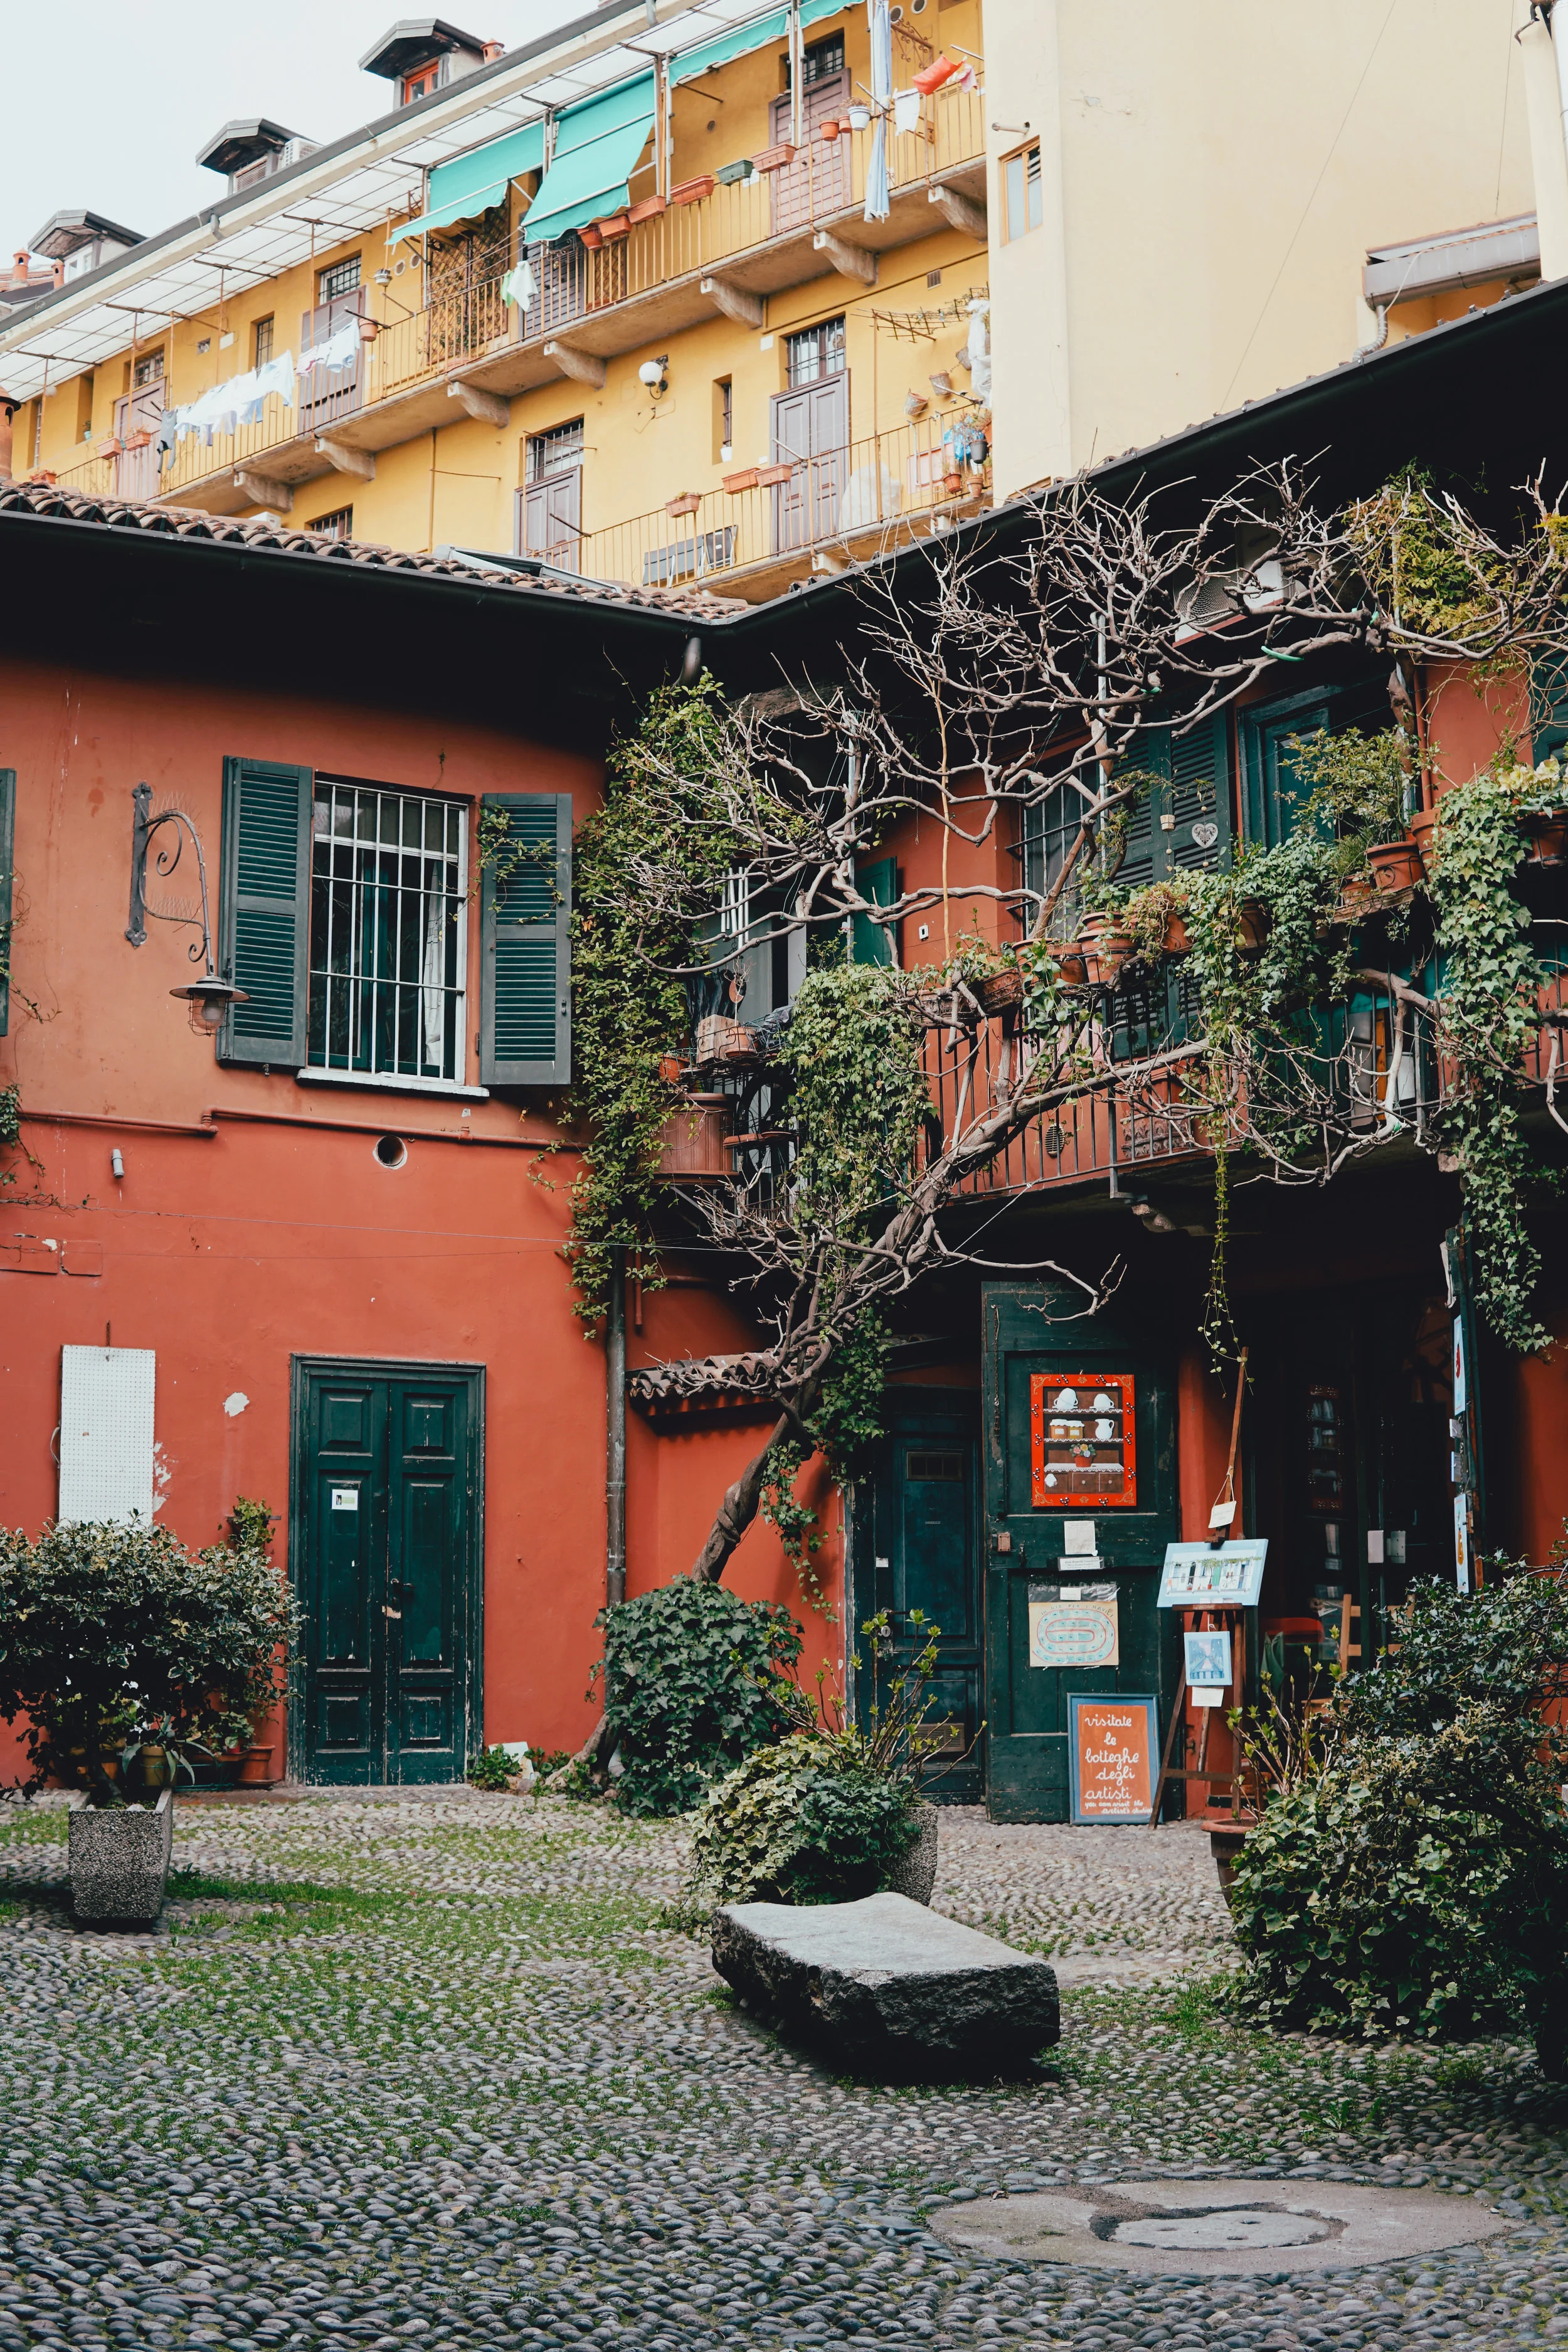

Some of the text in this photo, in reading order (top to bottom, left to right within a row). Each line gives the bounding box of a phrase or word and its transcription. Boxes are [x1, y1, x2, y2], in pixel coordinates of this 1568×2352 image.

[1084, 1714, 1132, 1727] visitate
[1104, 1732, 1116, 1745] le
[1084, 1747, 1139, 1771] botteghe
[1095, 1766, 1135, 1786] degli
[1084, 1786, 1132, 1799] artisti
